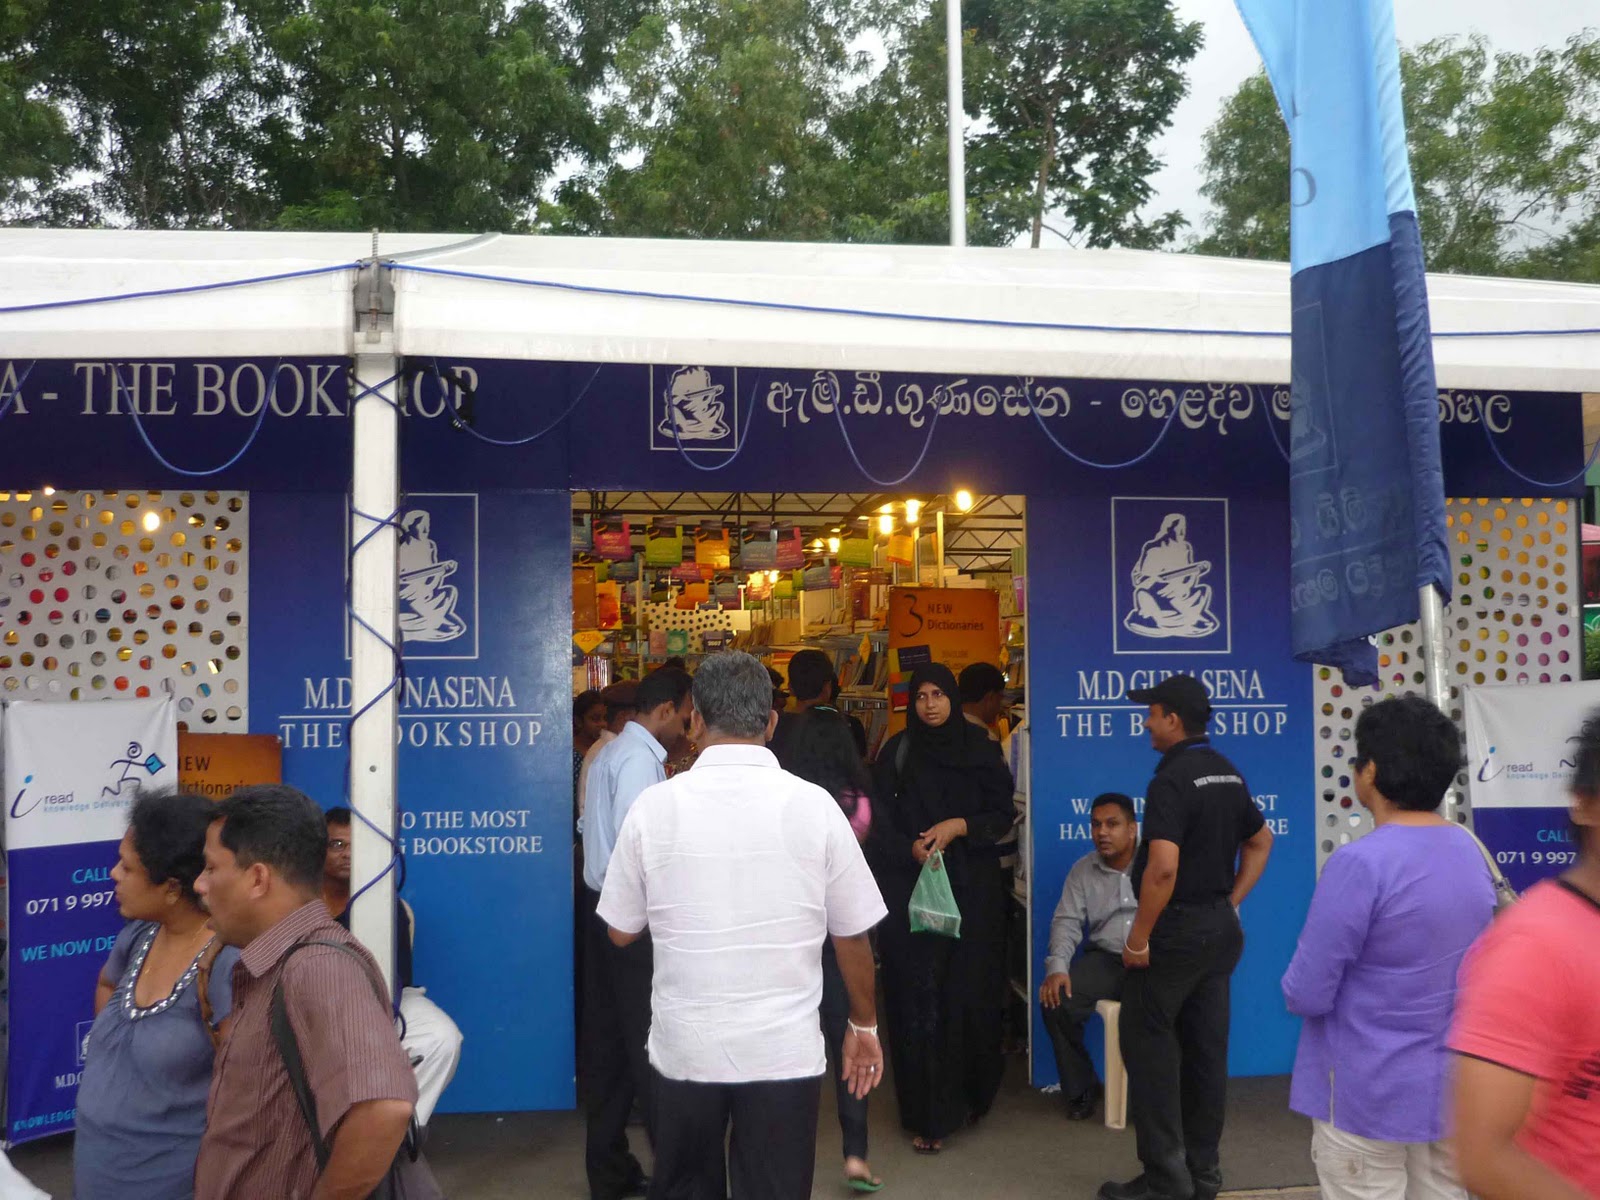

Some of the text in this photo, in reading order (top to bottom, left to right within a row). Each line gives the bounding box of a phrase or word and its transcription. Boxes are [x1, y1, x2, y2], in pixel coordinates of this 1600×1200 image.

[74, 362, 178, 416] THE
[899, 593, 924, 638] 3
[928, 603, 953, 614] NEW
[927, 619, 985, 631] Dictionaries
[1056, 711, 1288, 738] THE BSHOP
[279, 722, 343, 748] THE
[1507, 762, 1533, 772] read
[44, 792, 74, 805] read
[421, 811, 465, 829] THE
[470, 810, 531, 829] MOST
[413, 835, 543, 855] BOOKSTORE
[1536, 829, 1574, 842] CALL
[1496, 851, 1526, 864] 071
[1531, 851, 1543, 864] 9
[72, 867, 111, 885] CALL
[26, 897, 59, 915] 071
[65, 895, 78, 911] 9
[22, 946, 48, 962] WE
[51, 938, 94, 958] NOW
